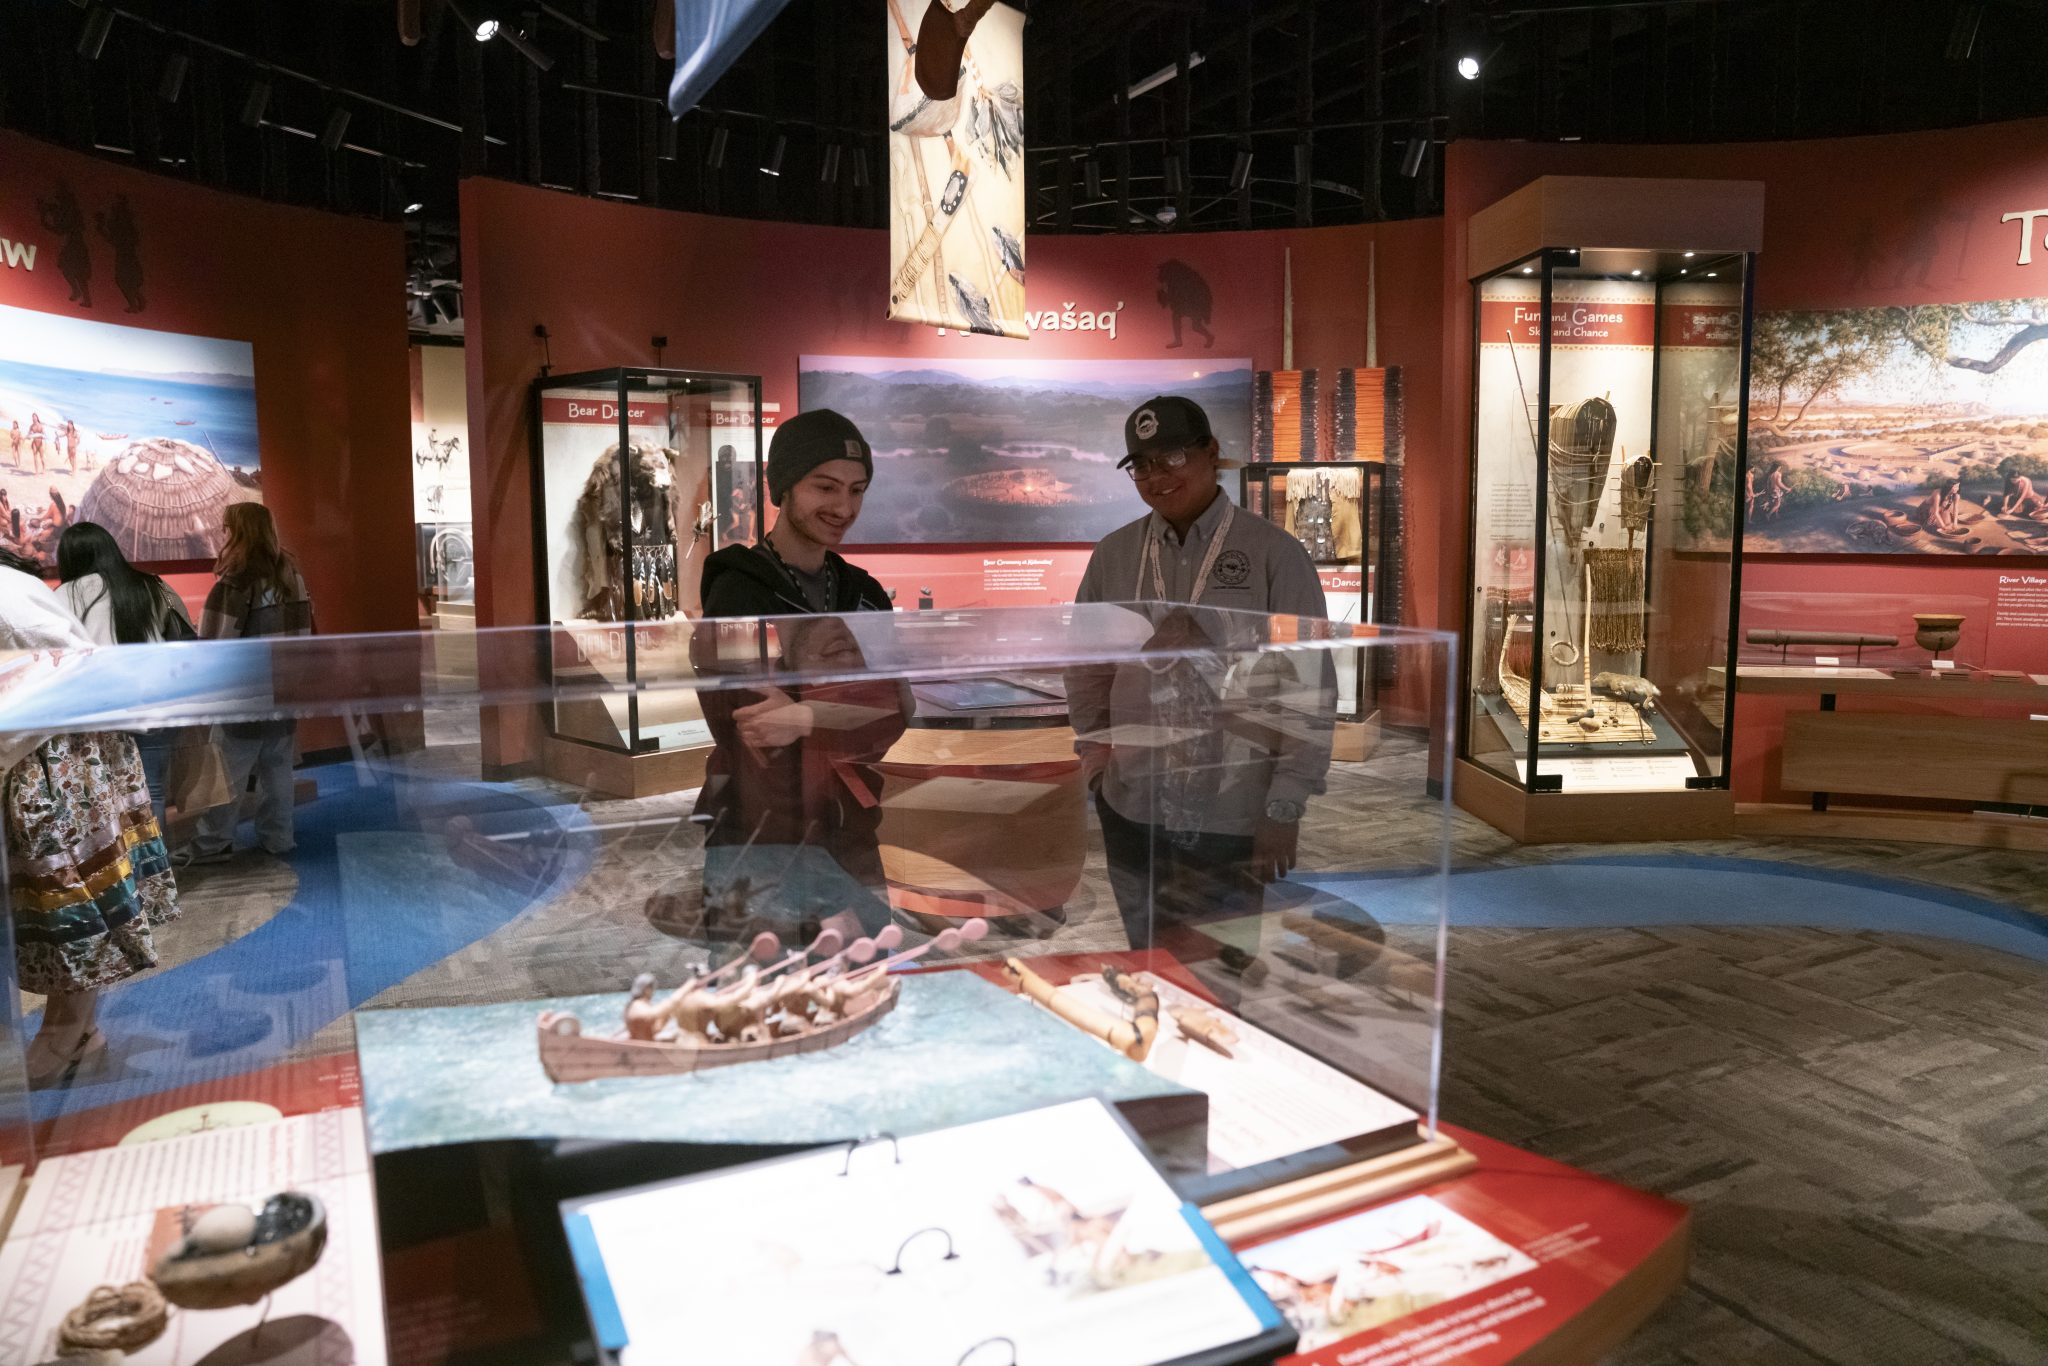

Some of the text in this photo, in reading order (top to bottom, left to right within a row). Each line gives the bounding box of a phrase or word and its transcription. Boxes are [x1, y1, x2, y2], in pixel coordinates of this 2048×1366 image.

[2001, 208, 2048, 266] T
[1514, 306, 1541, 325] Fun
[1572, 308, 1624, 326] Games
[1553, 327, 1609, 338] and Chance
[568, 402, 645, 419] Bear Dacer
[716, 413, 775, 425] Bear Dacer
[1320, 578, 1331, 586] the
[1999, 575, 2047, 586] River Village
